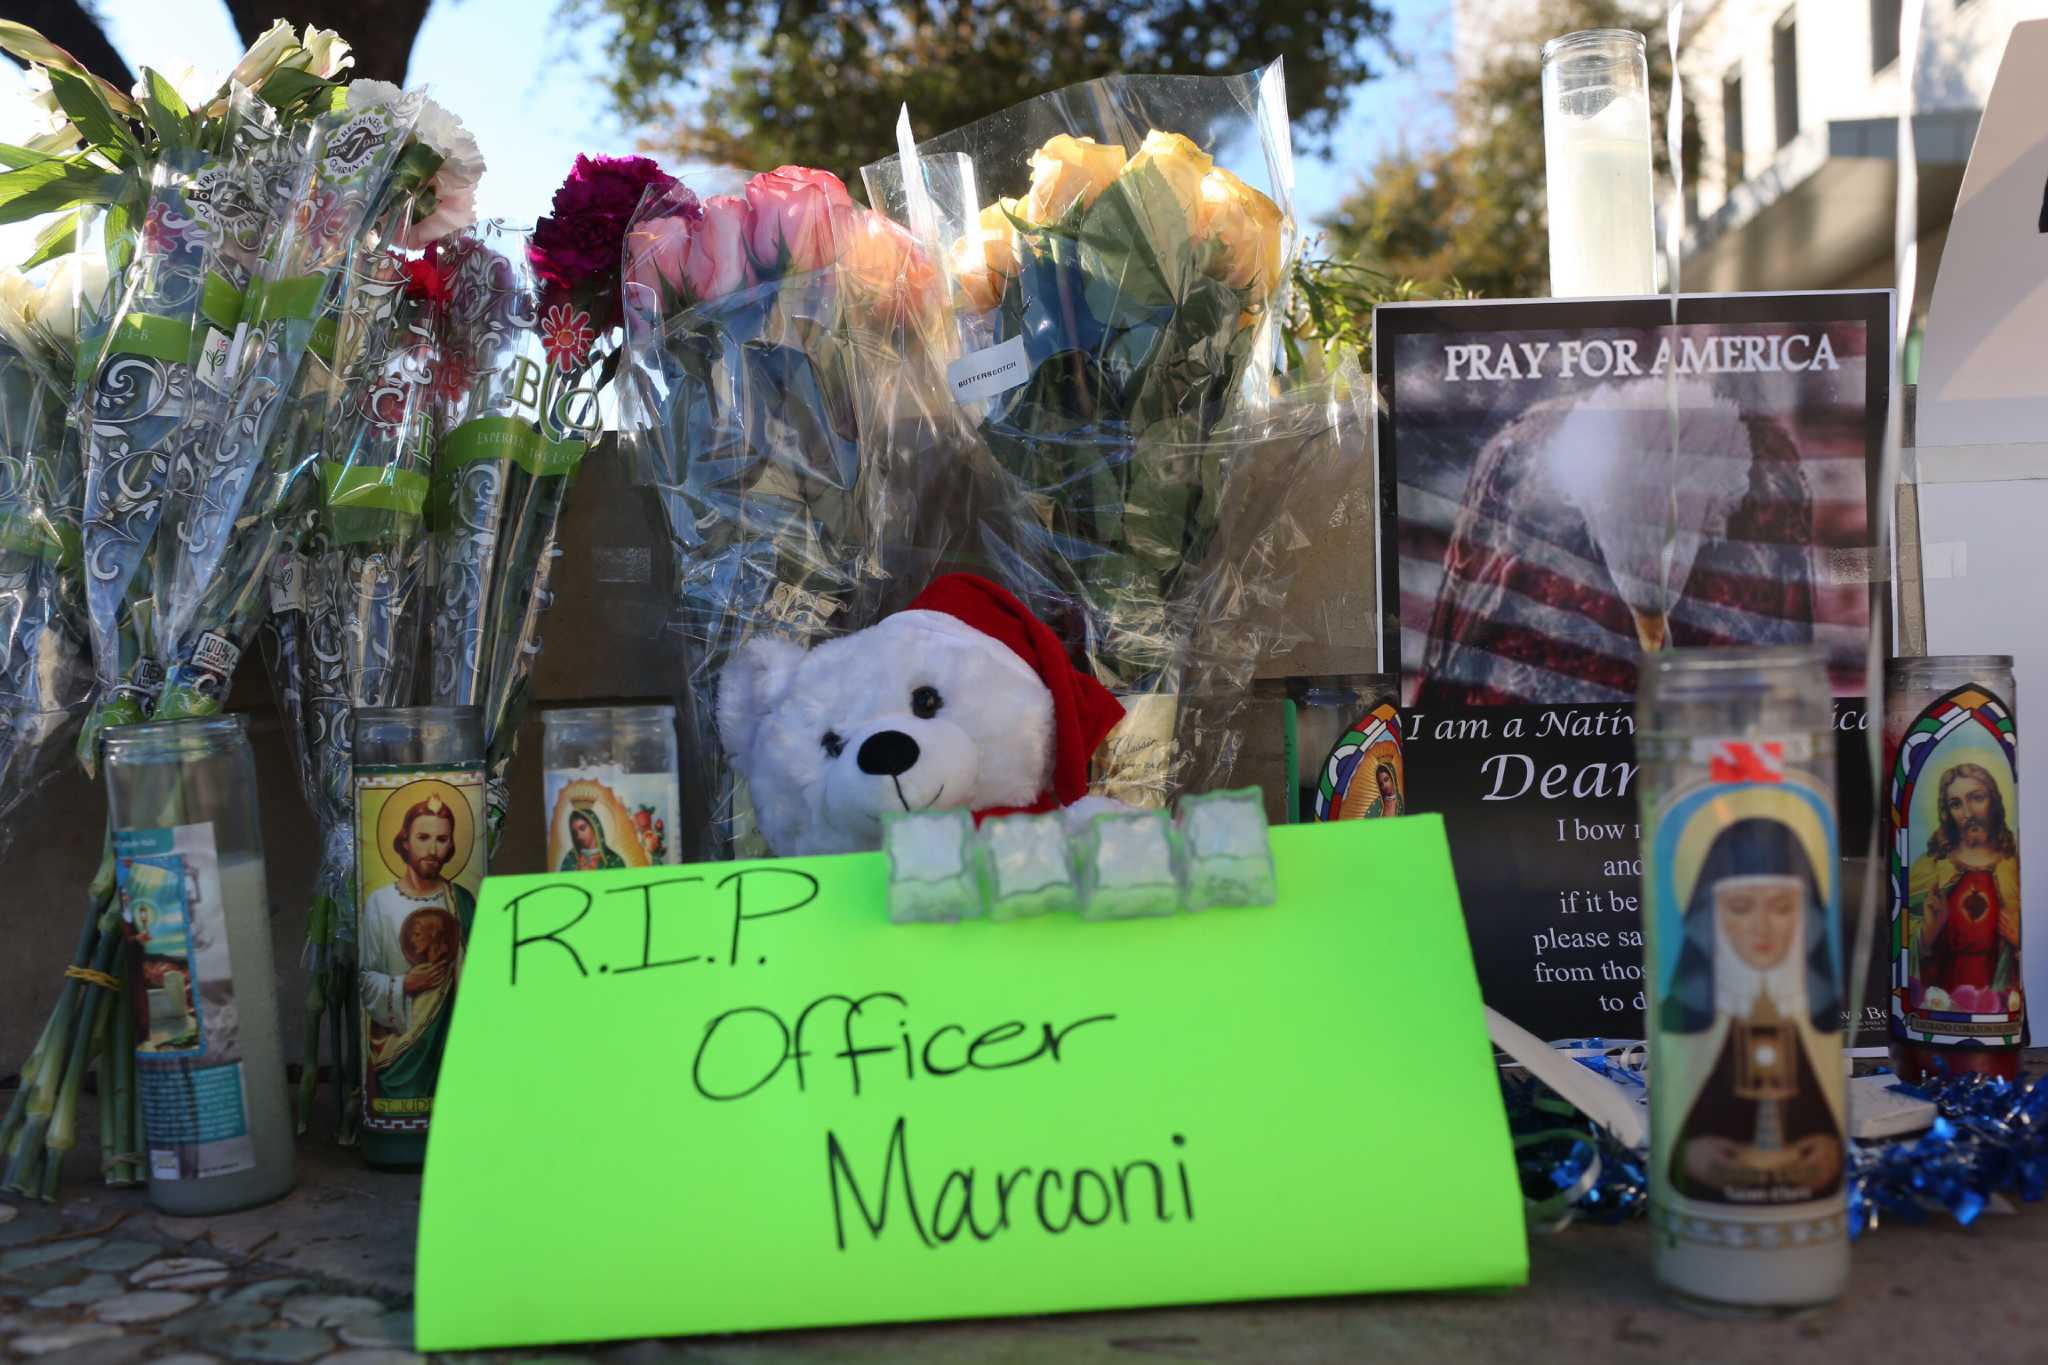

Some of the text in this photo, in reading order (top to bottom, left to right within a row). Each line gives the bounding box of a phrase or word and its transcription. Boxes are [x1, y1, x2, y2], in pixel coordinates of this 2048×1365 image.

[351, 131, 368, 159] 7
[1444, 332, 1841, 382] PRAY FOR AMERICA
[957, 360, 1017, 389] BUTTERSCOTCH
[1406, 714, 1425, 741] I
[1434, 718, 1492, 741] am
[1503, 717, 1526, 738] a
[1535, 708, 1638, 738] Nativ
[1556, 819, 1566, 841] I
[1574, 818, 1626, 841] bow
[1560, 890, 1580, 914] if
[1586, 890, 1603, 913] it
[1532, 928, 1611, 956] please
[1533, 961, 1595, 983] from
[1599, 994, 1625, 1012] to
[692, 992, 1117, 1102] Officer
[827, 1115, 1195, 1252] Marconi
